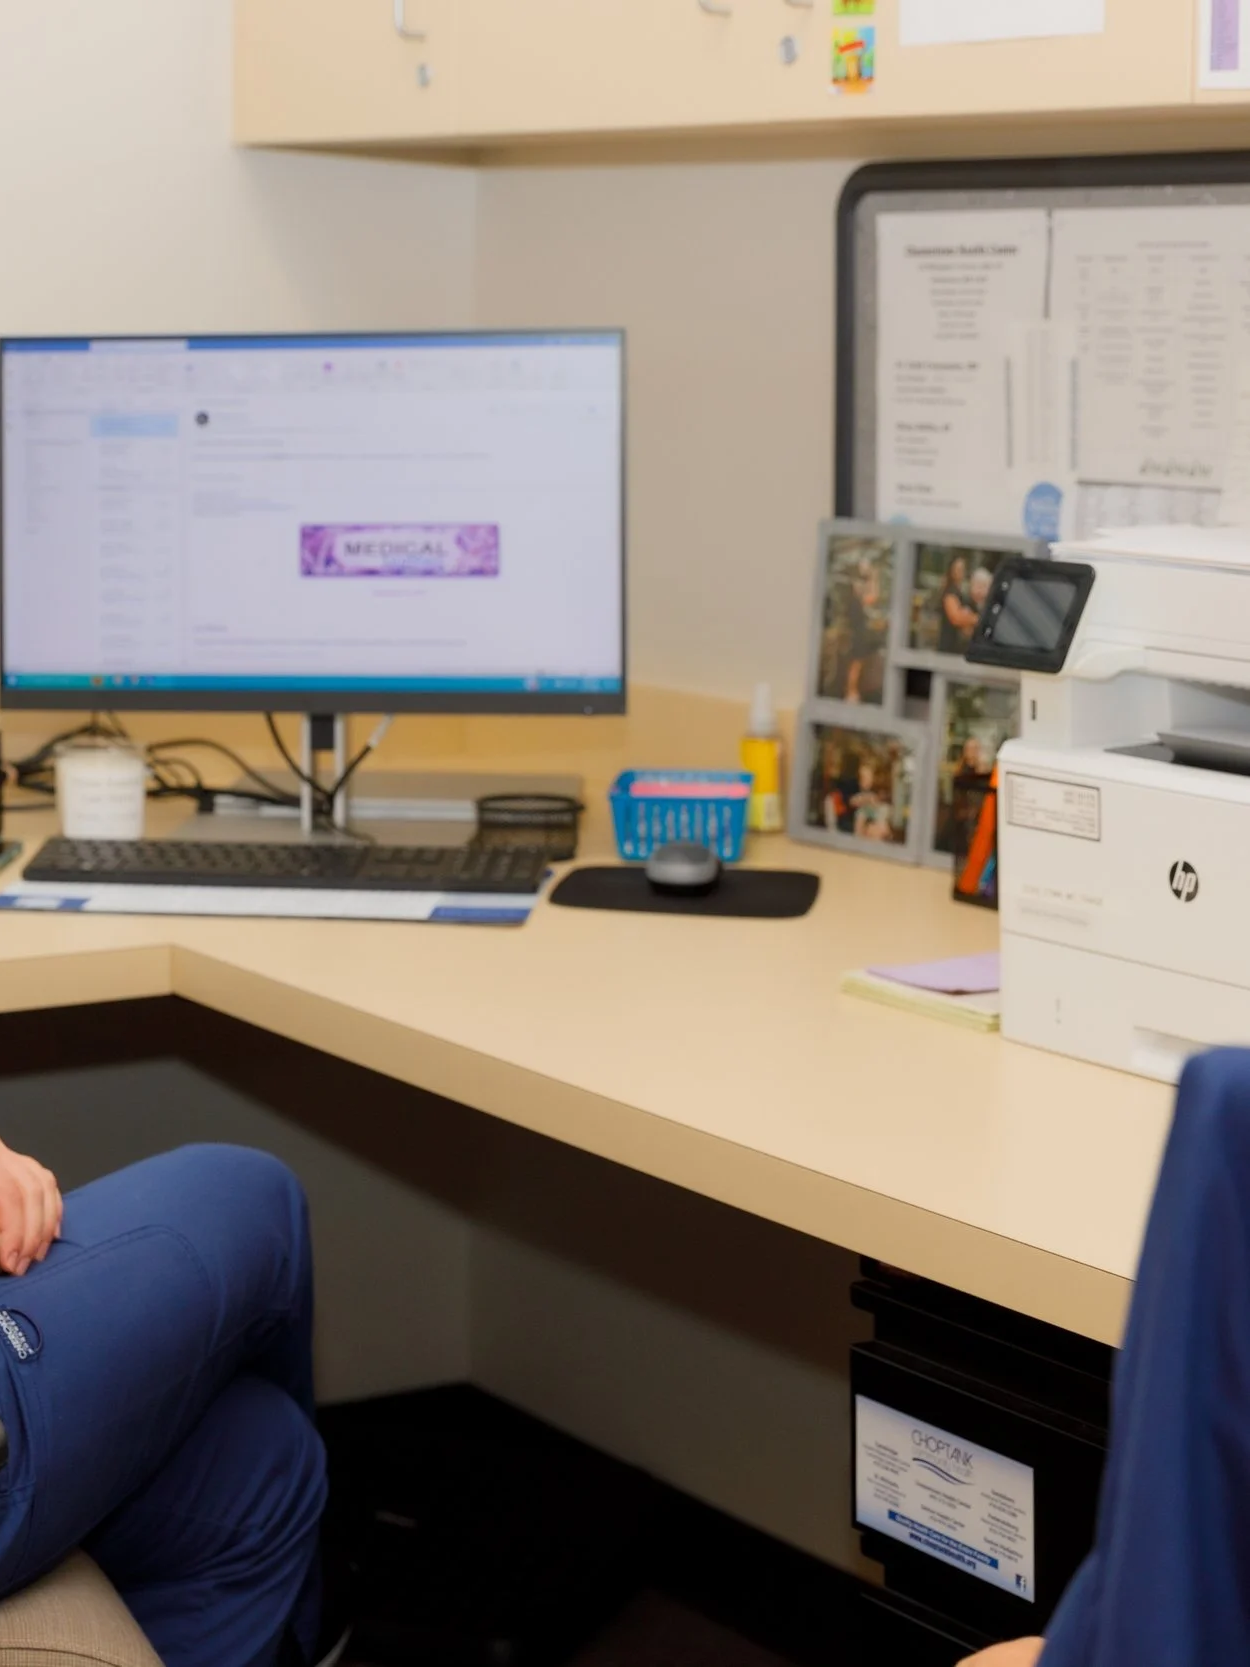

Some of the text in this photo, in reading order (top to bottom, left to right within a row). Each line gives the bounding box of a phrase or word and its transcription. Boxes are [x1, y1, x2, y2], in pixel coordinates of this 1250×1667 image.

[344, 539, 447, 557] MEDICAL
[1170, 860, 1199, 903] hp
[911, 1429, 974, 1469] CHOPTANK
